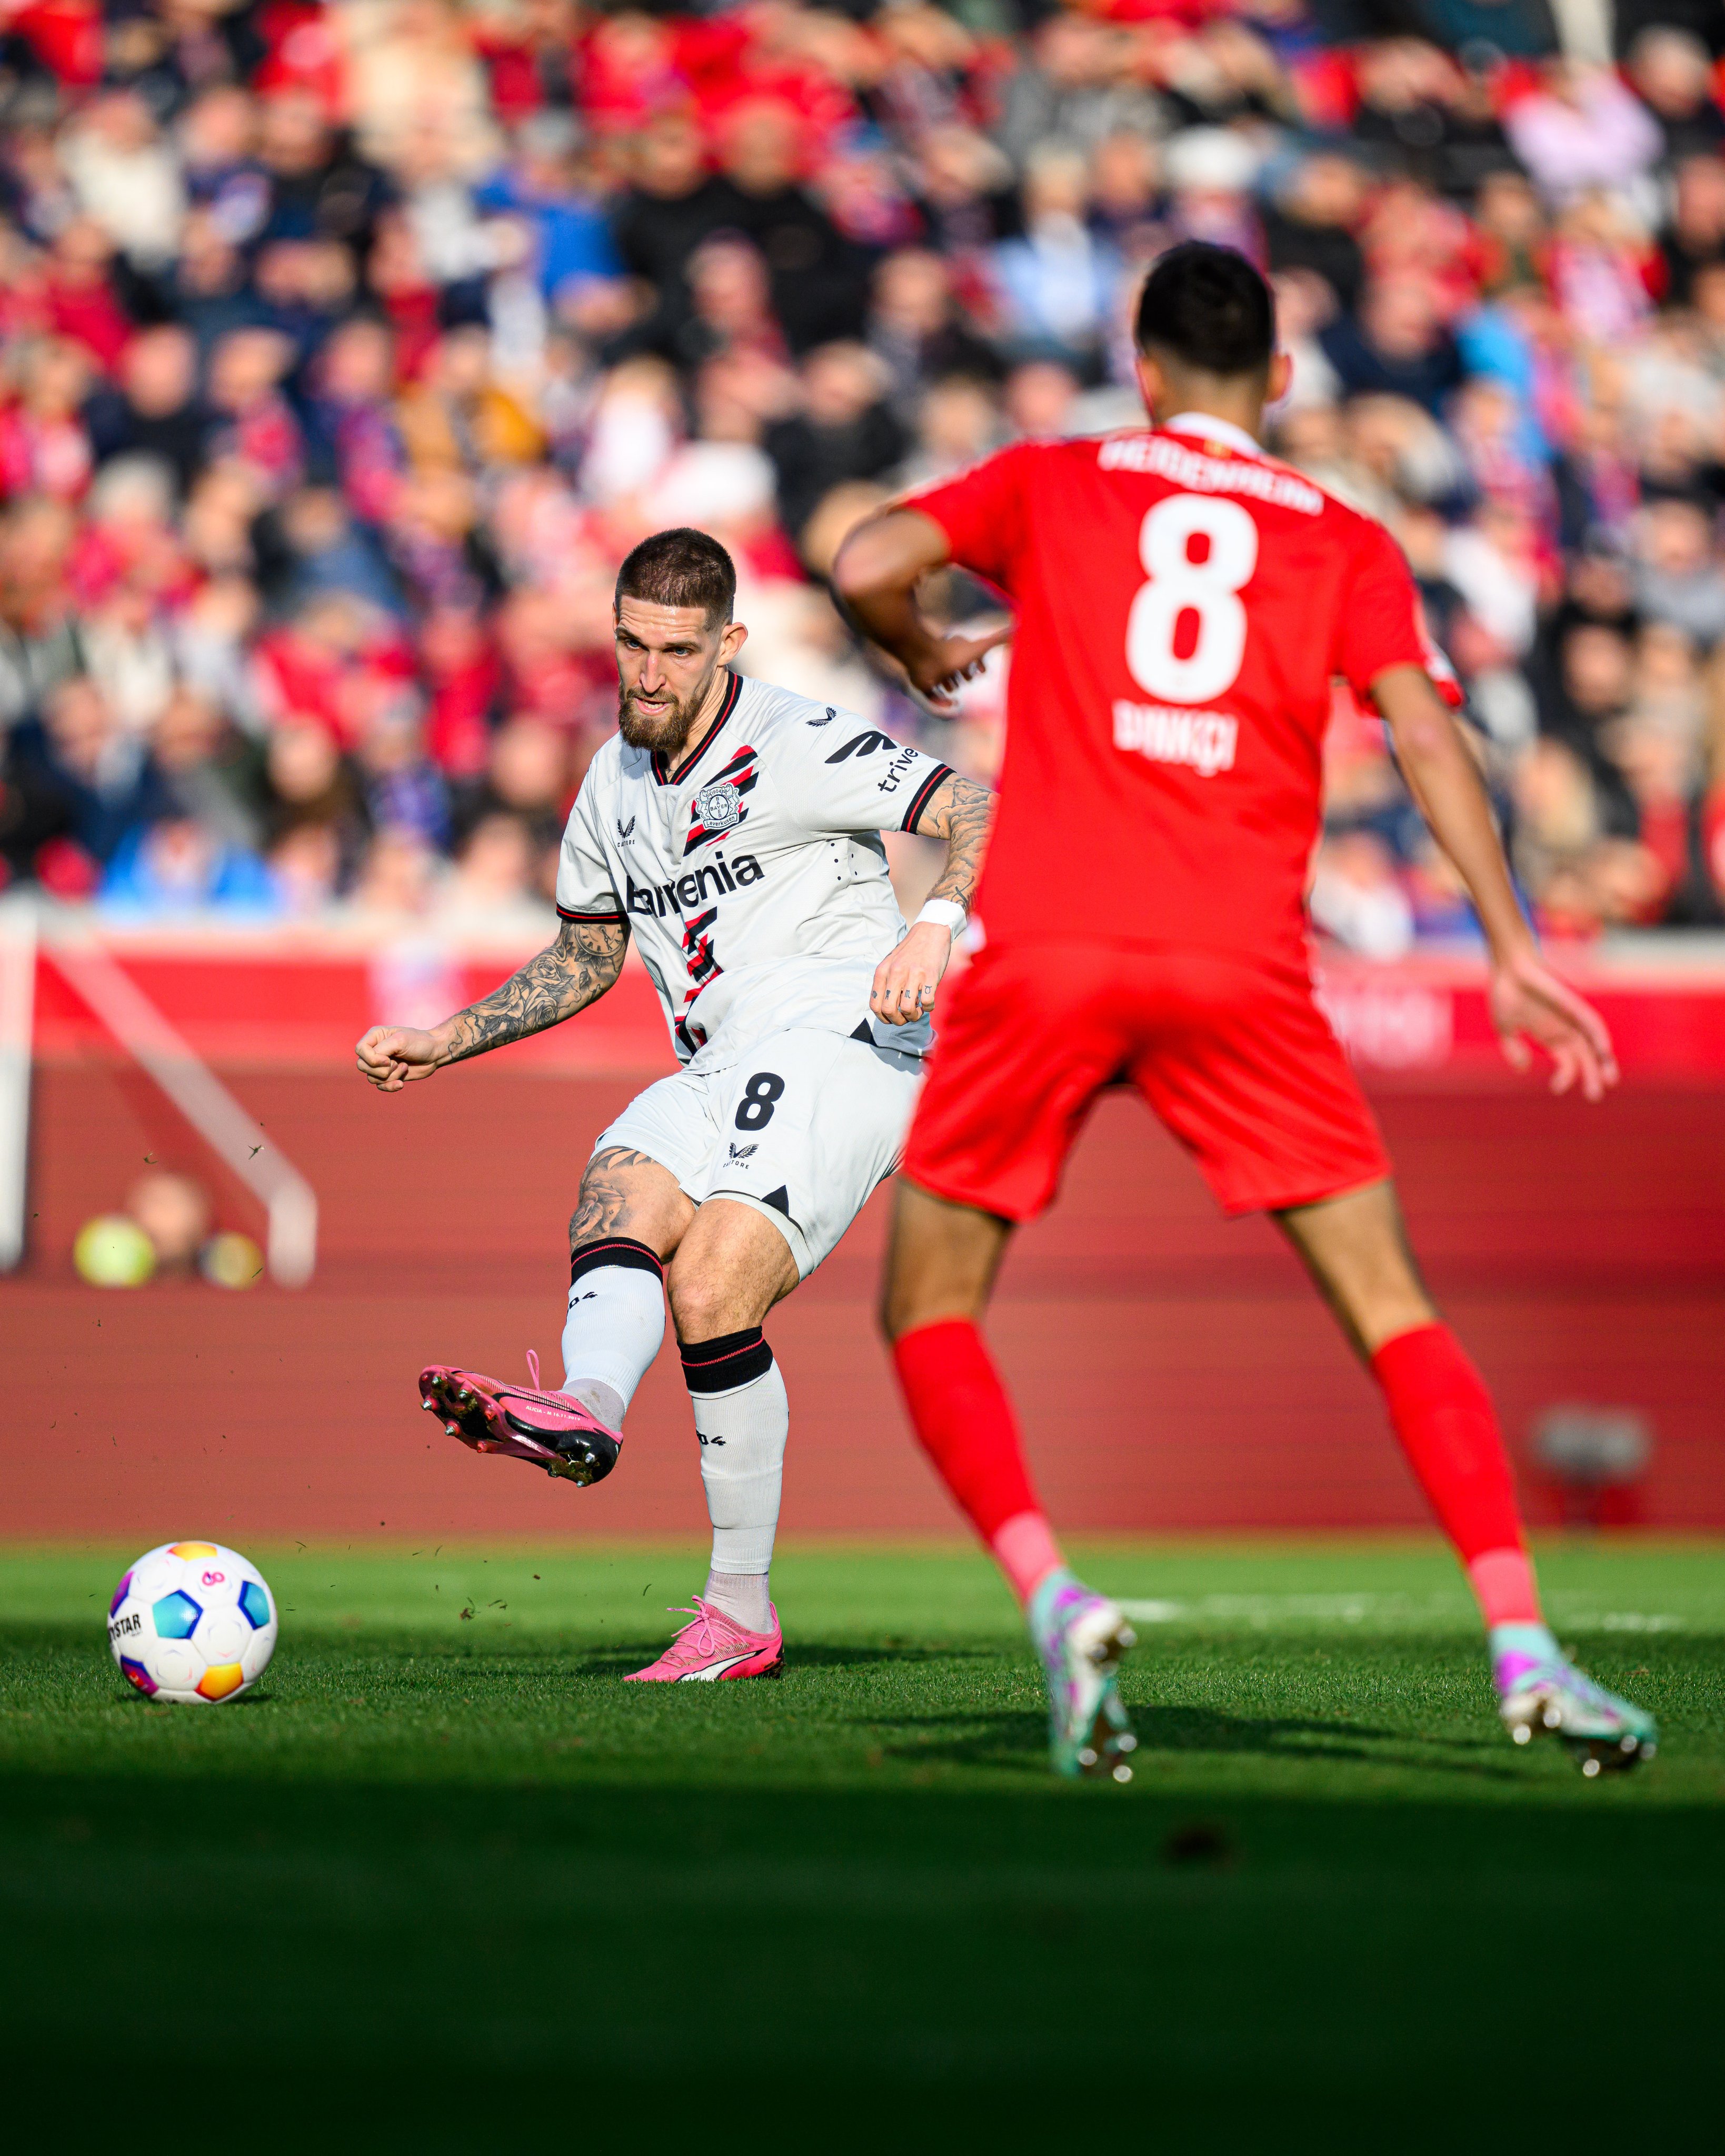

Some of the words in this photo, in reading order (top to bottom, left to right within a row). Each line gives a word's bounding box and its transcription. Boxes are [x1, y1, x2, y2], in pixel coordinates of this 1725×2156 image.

[1125, 493, 1259, 704] 8
[877, 747, 919, 792] trive
[706, 816, 735, 826] Leverkusen
[735, 1072, 785, 1131] 8
